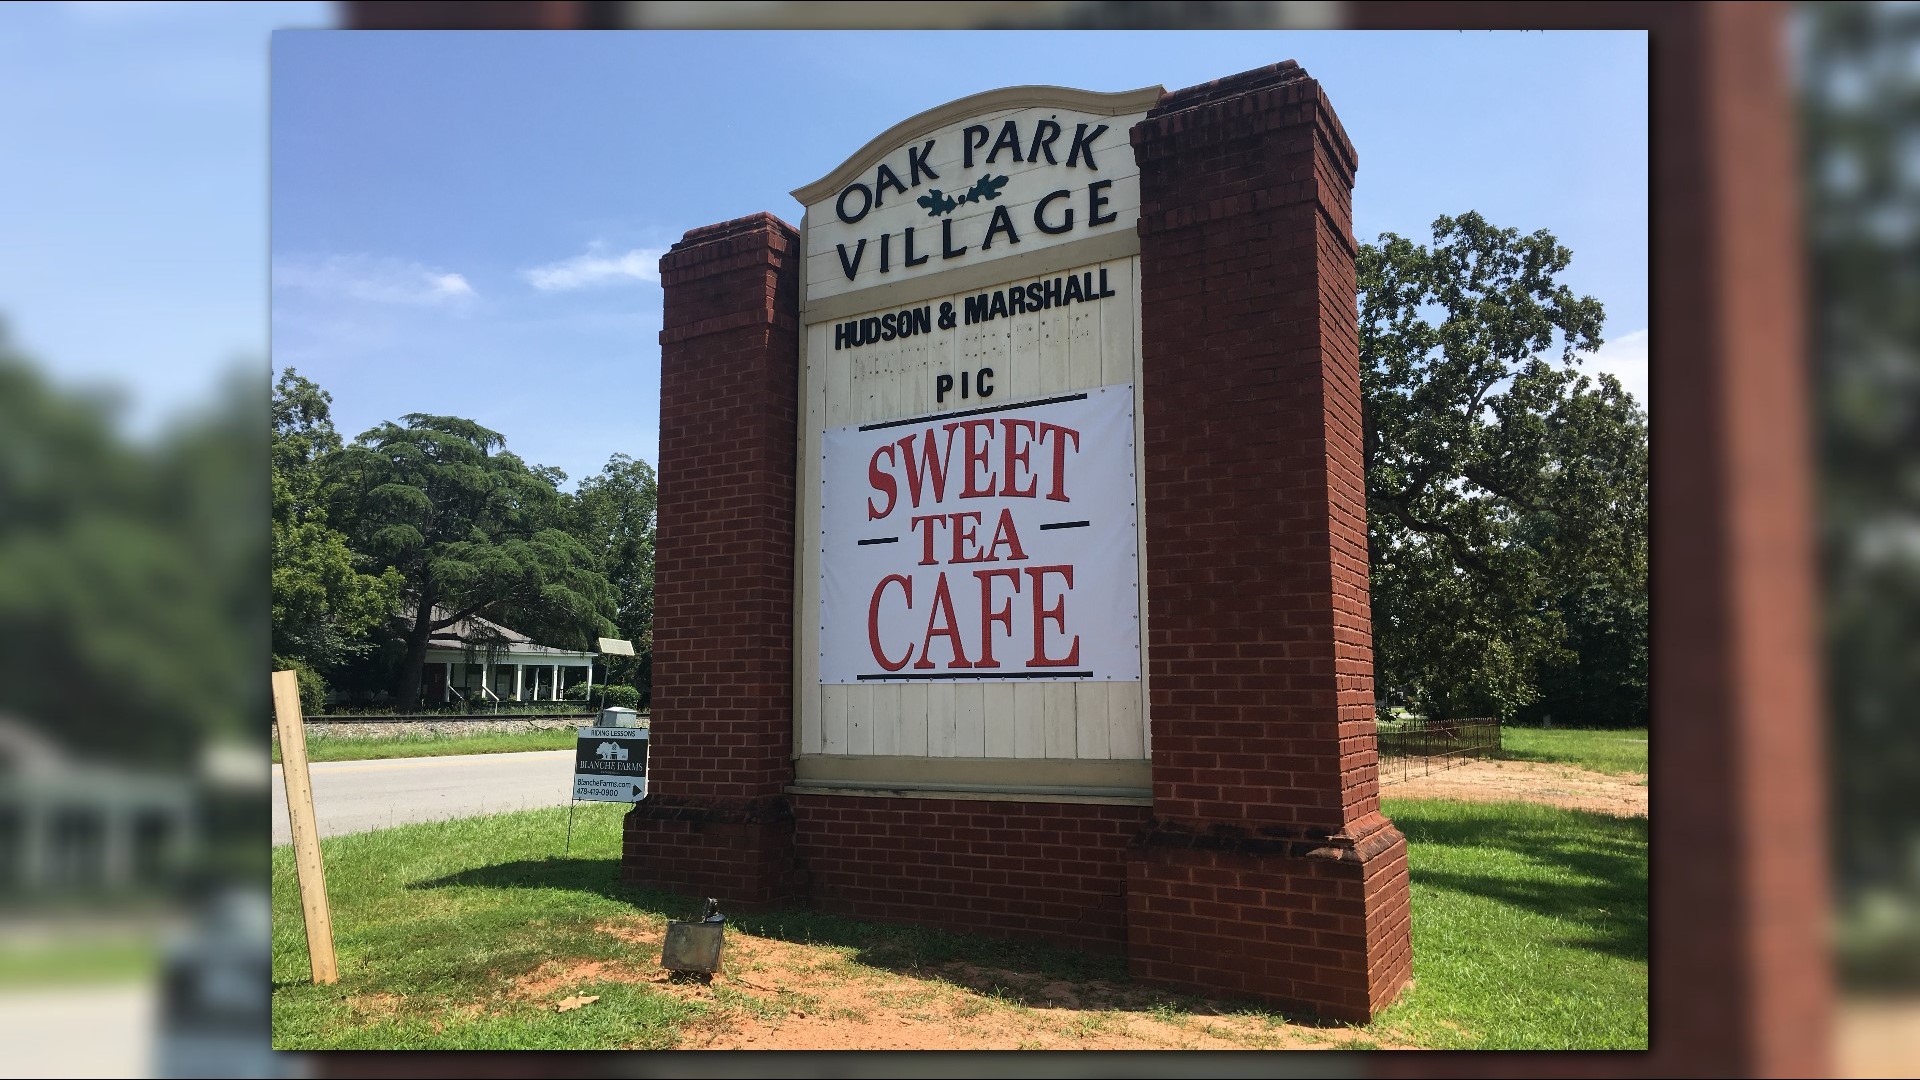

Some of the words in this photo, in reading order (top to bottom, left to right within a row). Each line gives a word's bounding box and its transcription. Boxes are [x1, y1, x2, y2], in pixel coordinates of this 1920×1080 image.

[835, 139, 940, 224] OAK
[962, 119, 1110, 171] PARK
[836, 179, 1118, 282] VILLAGE
[835, 305, 931, 351] HUDSON
[937, 301, 957, 331] &
[964, 268, 1116, 326] MARSHALL
[936, 367, 994, 403] PIC
[867, 418, 1080, 522] SWEET
[911, 508, 1029, 566] TEA
[867, 564, 1080, 672] CAFE
[580, 760, 616, 770] BLANCHE
[617, 761, 643, 772] FARMS
